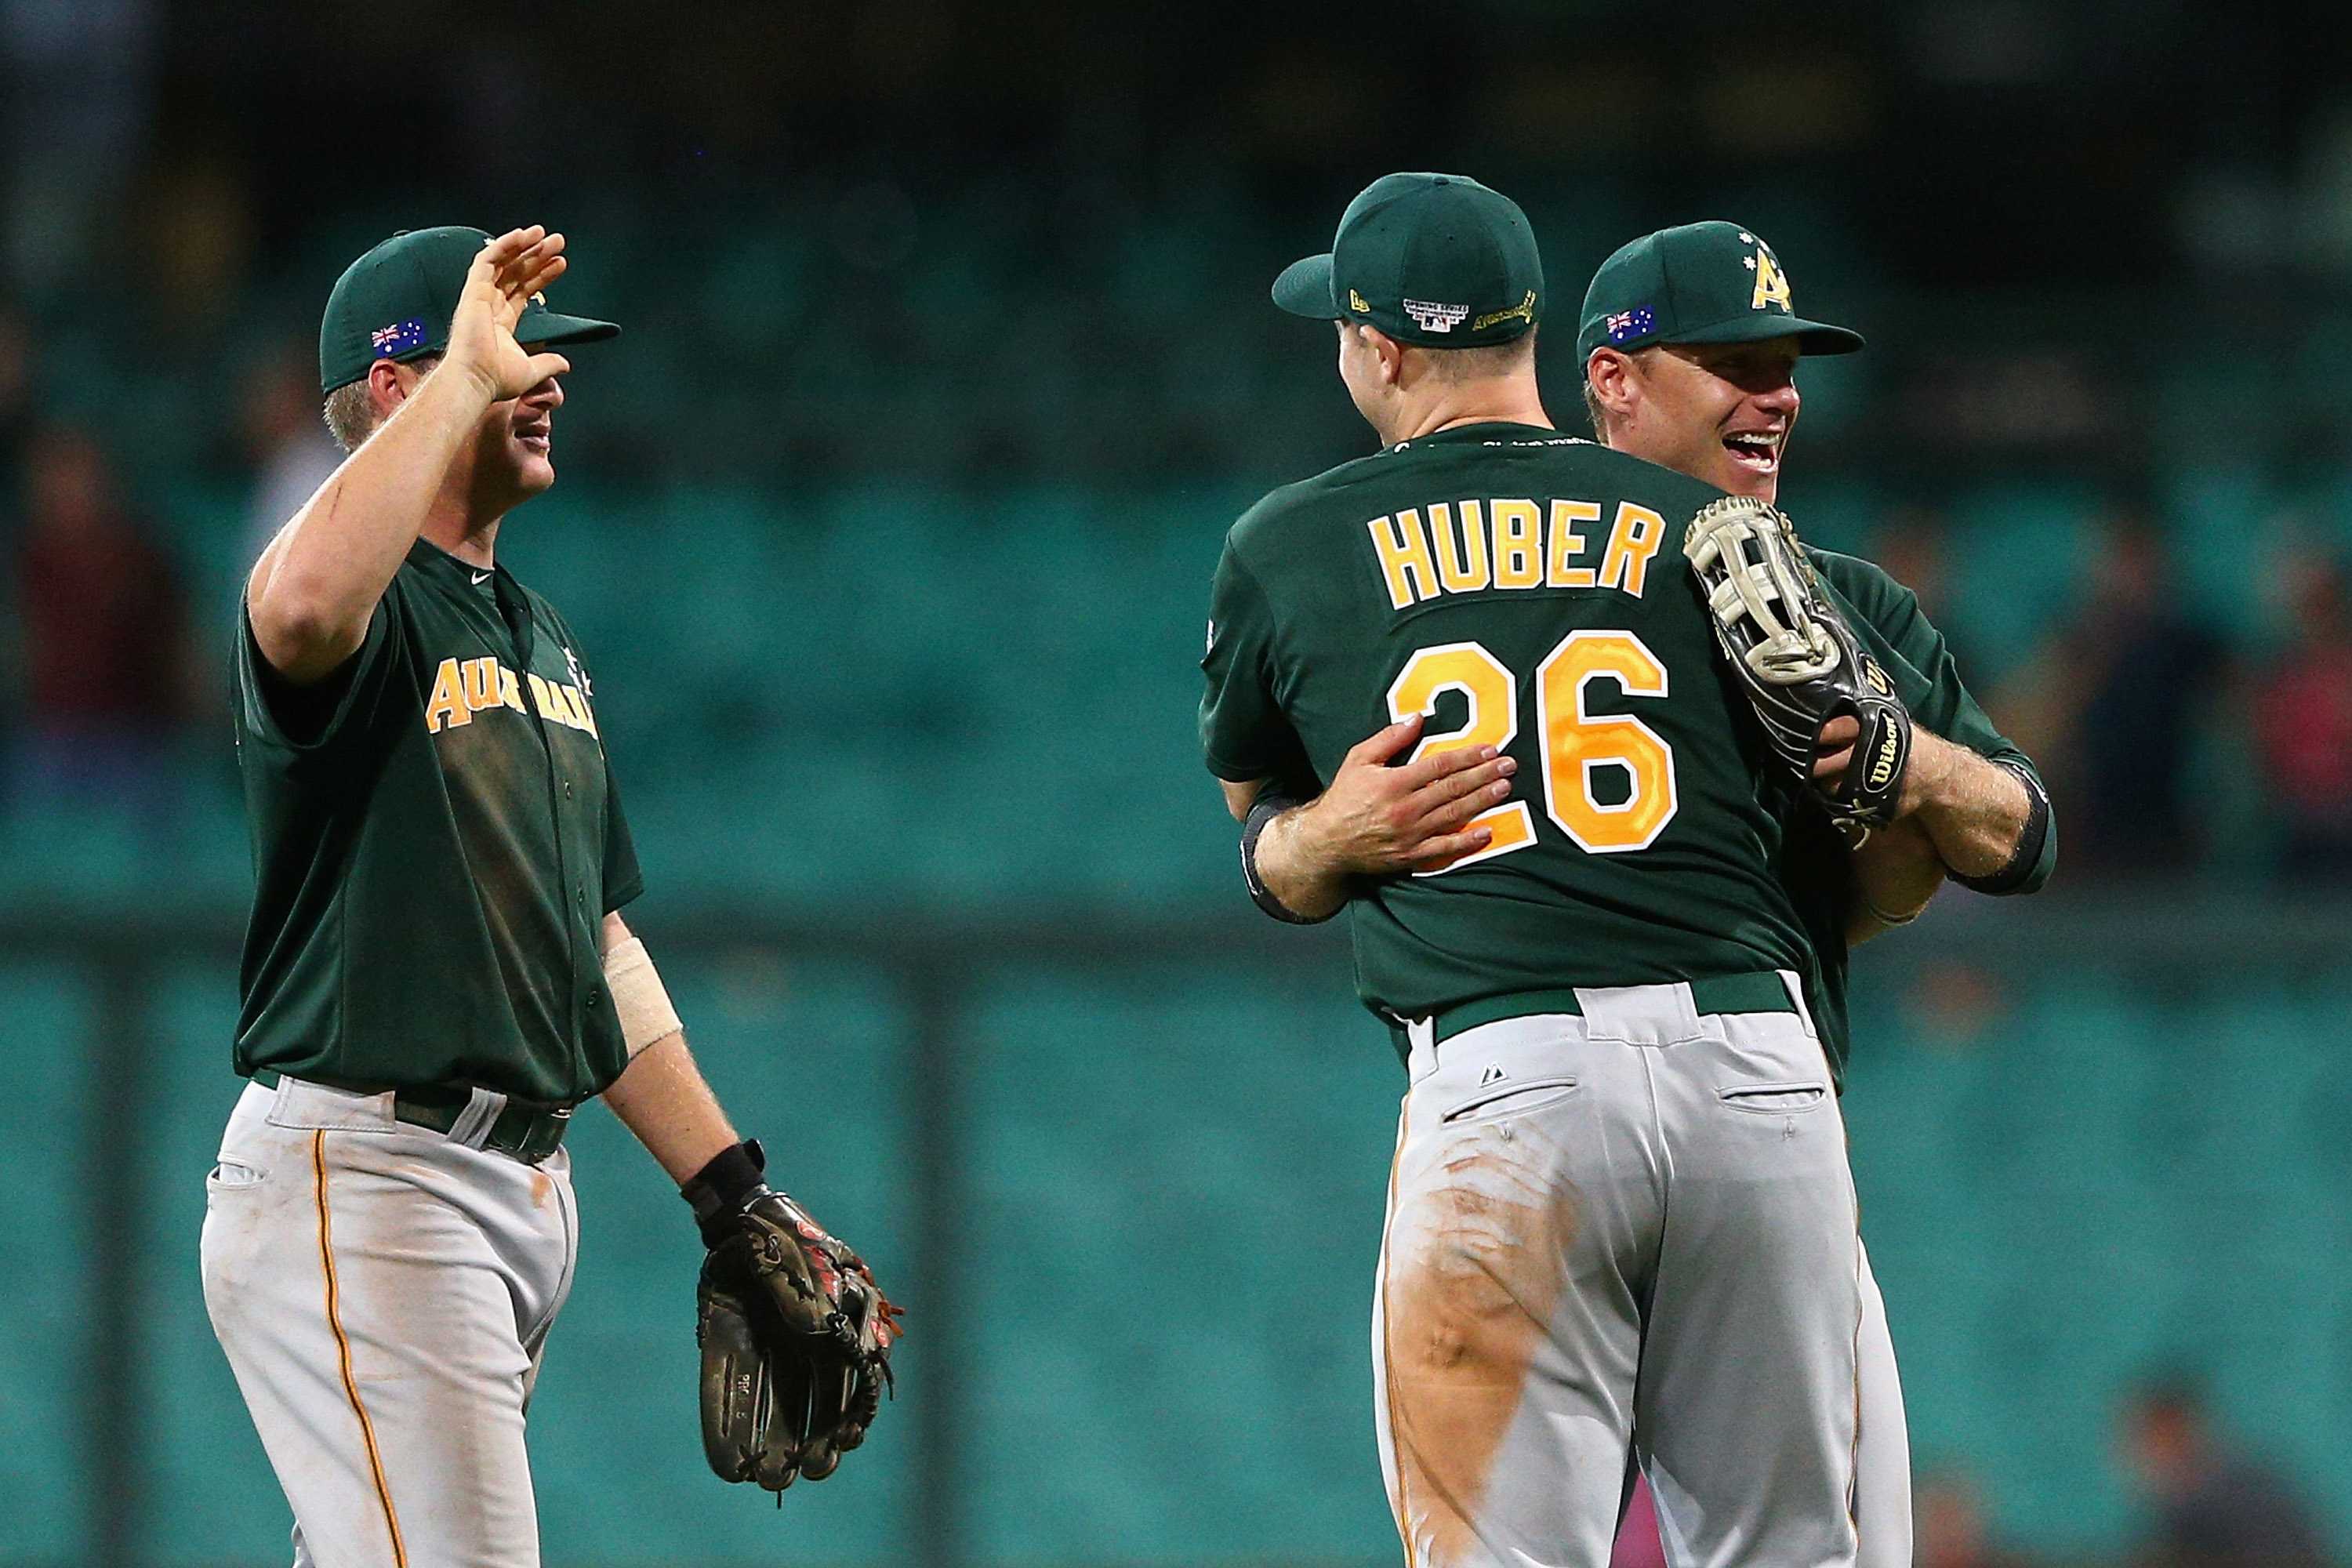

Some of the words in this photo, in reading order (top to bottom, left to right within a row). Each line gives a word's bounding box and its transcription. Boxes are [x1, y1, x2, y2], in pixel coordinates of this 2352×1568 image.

[1367, 499, 1666, 610] HUBER
[1386, 630, 1678, 877] 26
[1870, 713, 1896, 782] Wilson
